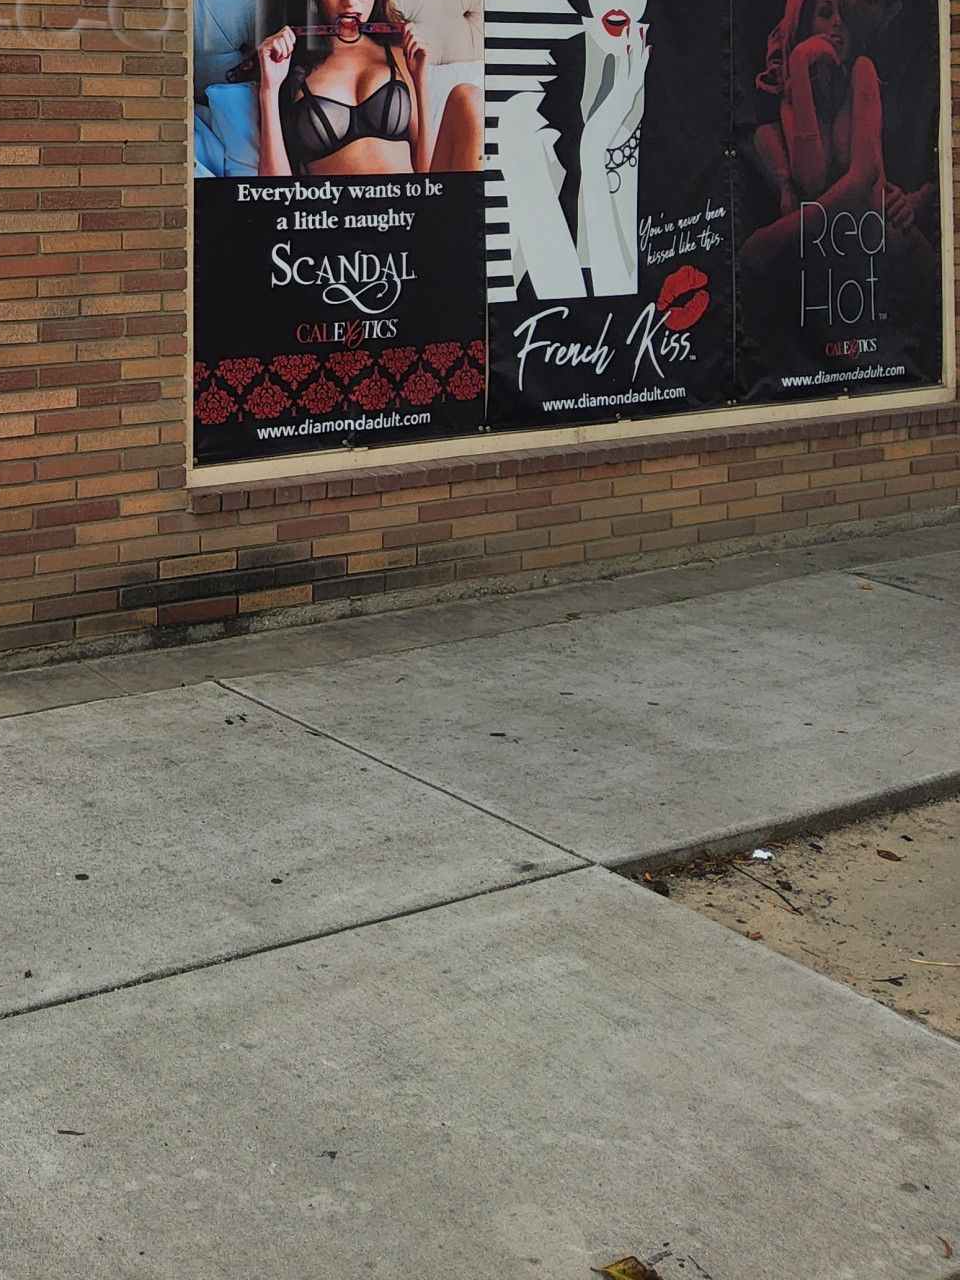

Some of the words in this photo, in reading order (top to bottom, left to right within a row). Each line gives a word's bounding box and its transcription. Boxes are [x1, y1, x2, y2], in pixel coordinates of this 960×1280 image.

[237, 181, 344, 205] Everybody
[348, 182, 401, 199] wants
[405, 182, 421, 196] to
[425, 178, 443, 196] be
[276, 217, 288, 230] a
[294, 211, 338, 229] little
[344, 209, 415, 232] naughty
[639, 212, 674, 251] You've
[677, 212, 702, 229] never
[705, 199, 726, 221] been
[800, 188, 885, 258] Red
[646, 235, 677, 265] kissed
[679, 231, 697, 254] like
[697, 225, 724, 251] this.
[800, 256, 879, 327] Hot
[513, 306, 615, 391] French
[626, 302, 691, 382] Kiss
[781, 365, 905, 387] www.diamondadult.com
[542, 385, 686, 412] www.diamondadult.com
[257, 411, 431, 439] www.diamondadult.com
